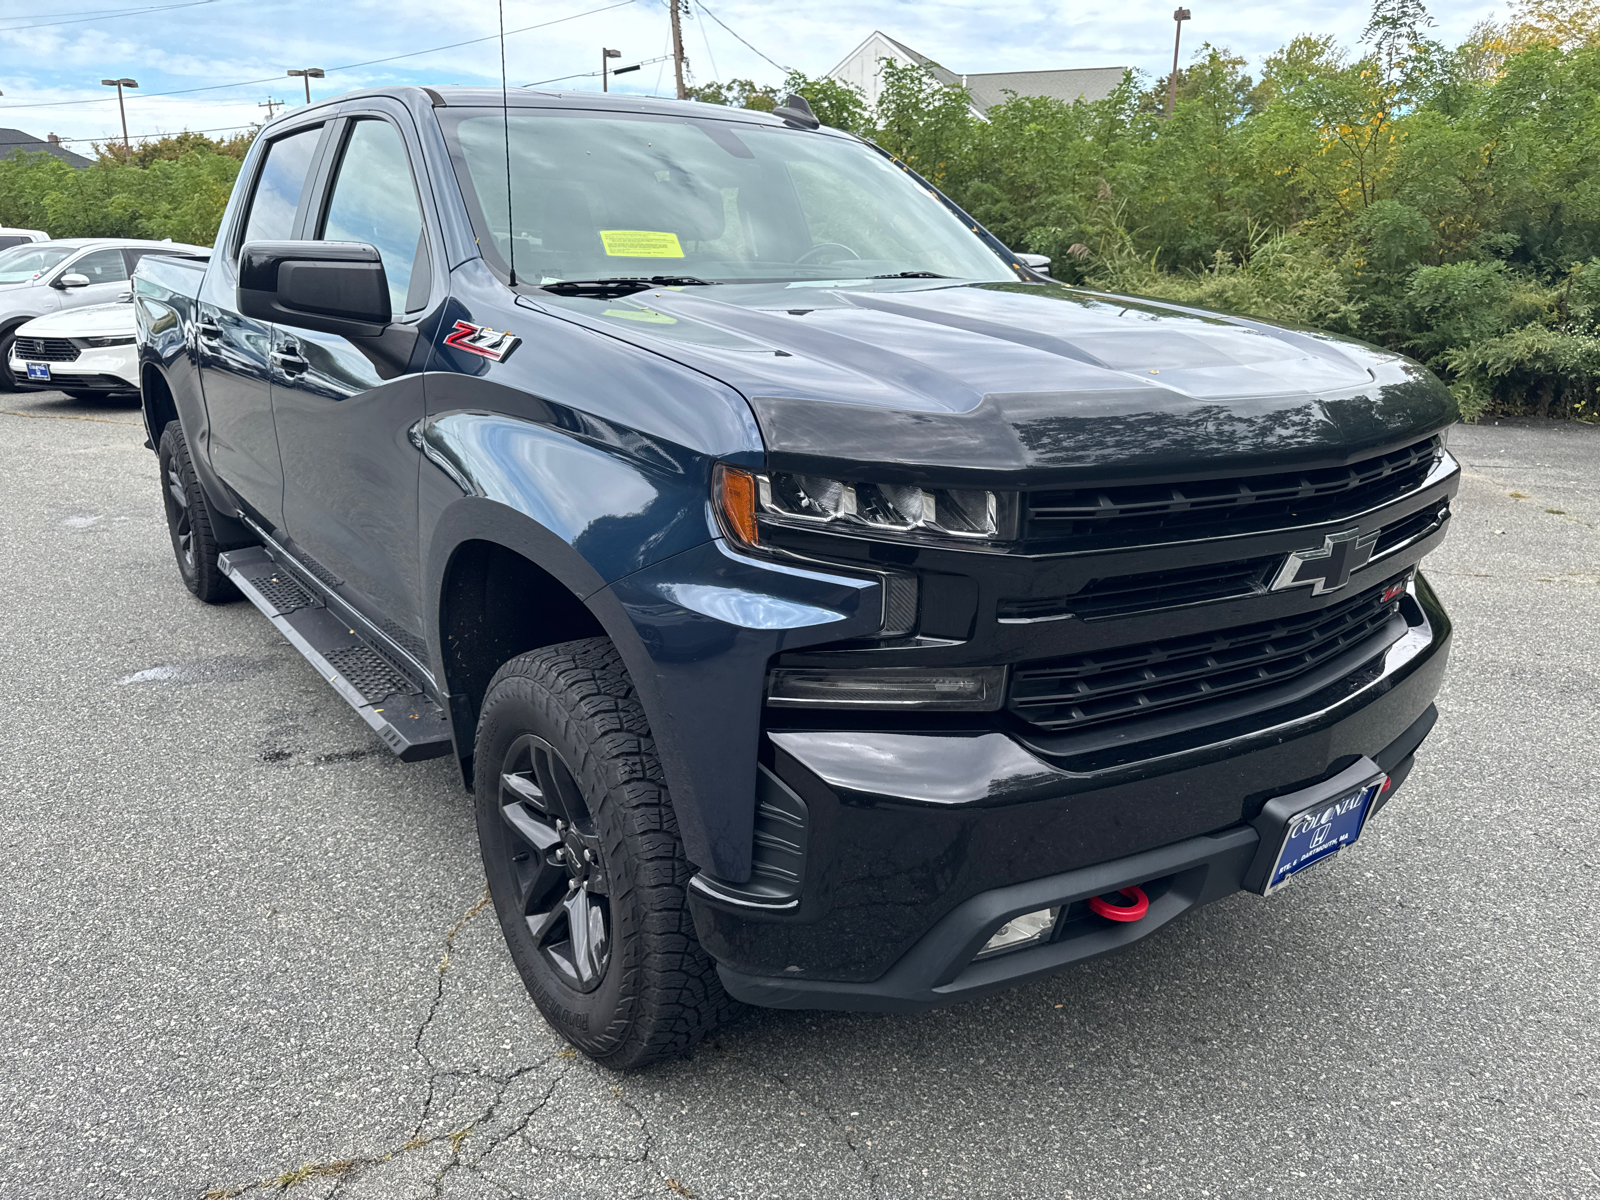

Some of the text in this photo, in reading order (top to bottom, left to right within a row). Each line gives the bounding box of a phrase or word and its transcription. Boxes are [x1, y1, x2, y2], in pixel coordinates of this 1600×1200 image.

[443, 319, 522, 364] Z71
[1291, 791, 1362, 838] COLONIAL
[1339, 833, 1349, 841] MA
